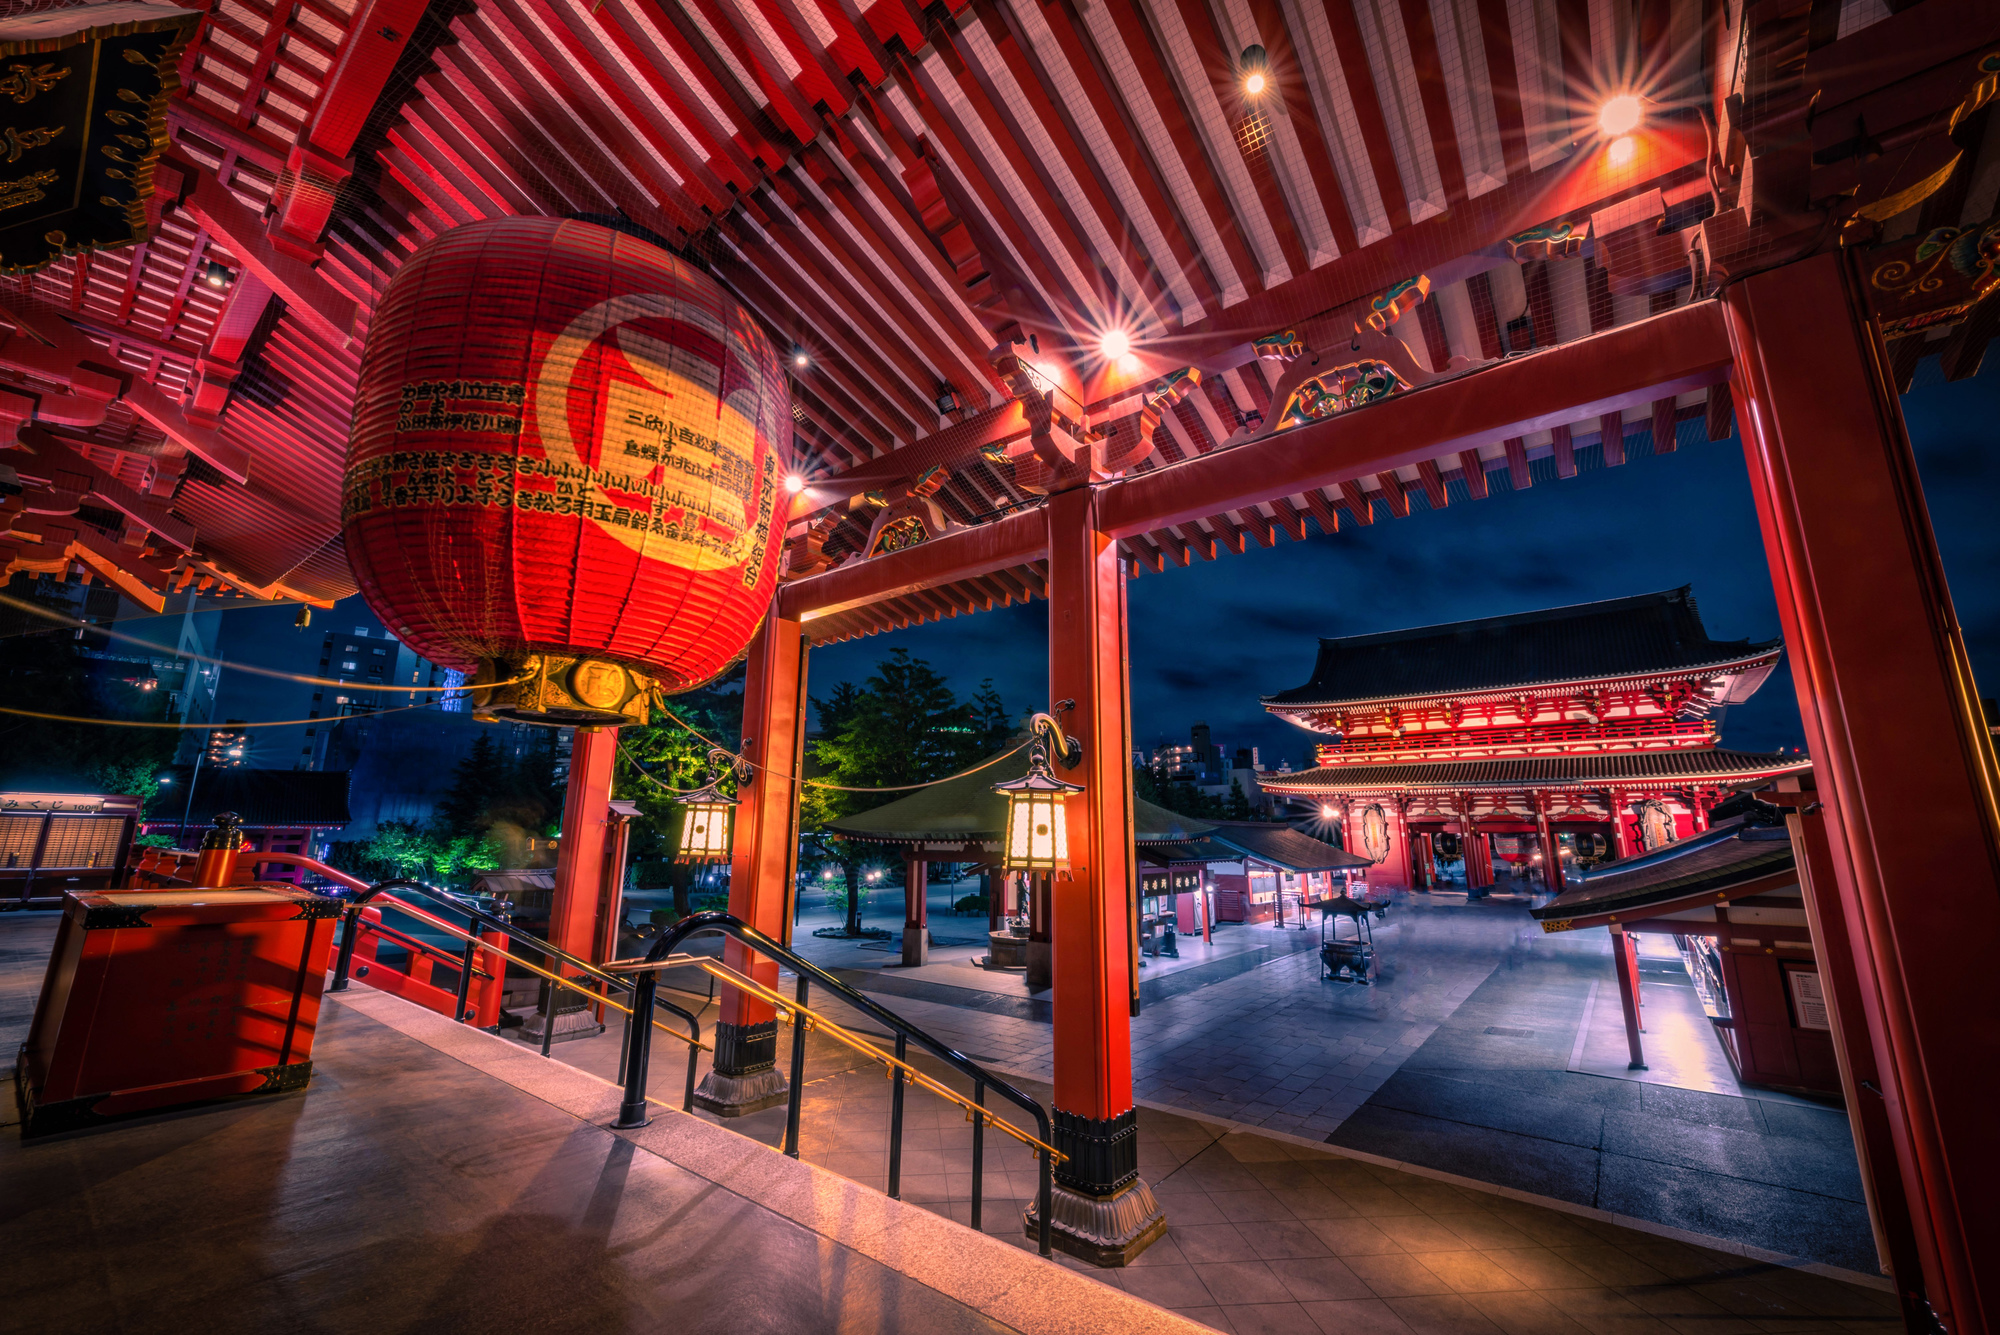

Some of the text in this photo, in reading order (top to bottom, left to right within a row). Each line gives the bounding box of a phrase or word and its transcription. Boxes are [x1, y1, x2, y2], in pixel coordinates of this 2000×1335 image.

[592, 470, 613, 523] 小玉
[744, 453, 776, 588] 東京新橋組合
[72, 803, 100, 812] 100円
